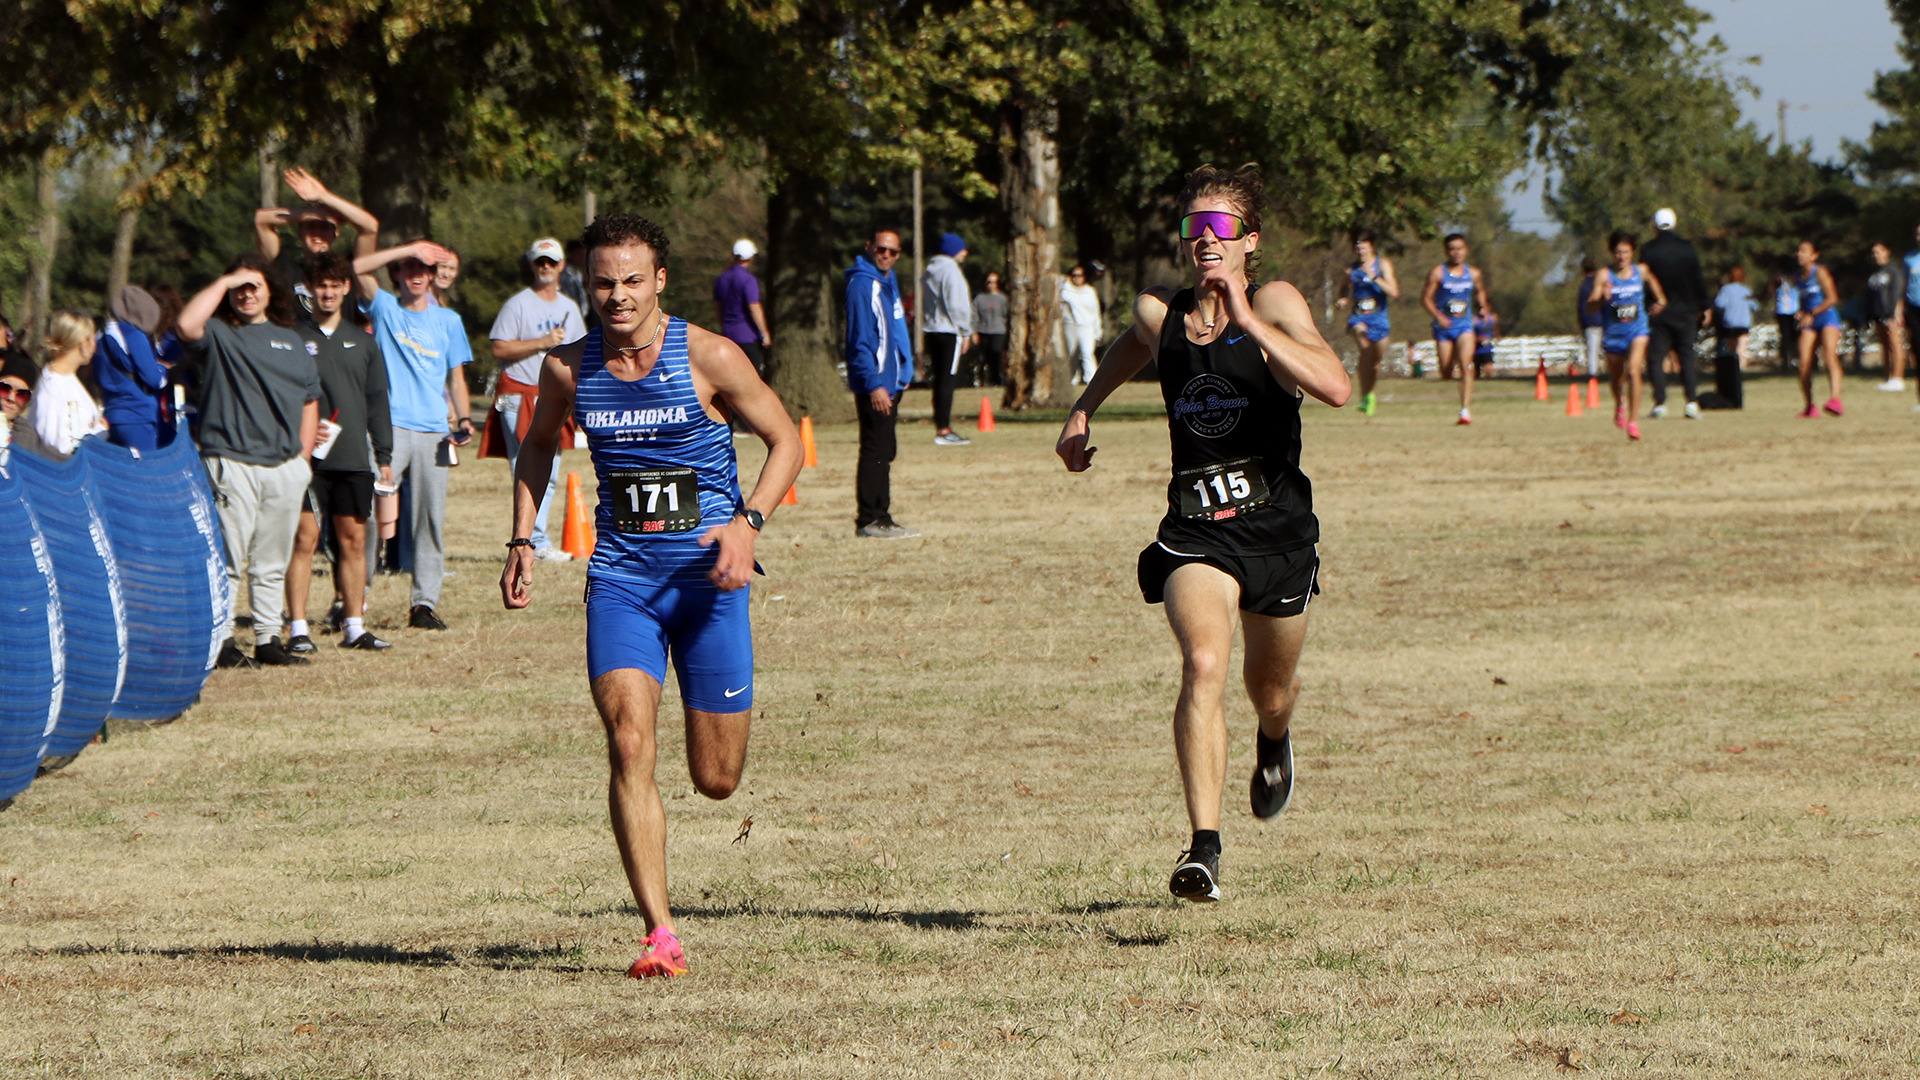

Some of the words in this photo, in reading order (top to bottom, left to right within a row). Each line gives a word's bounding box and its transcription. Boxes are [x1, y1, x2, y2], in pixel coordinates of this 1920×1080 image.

[1186, 378, 1205, 395] CROSS
[1206, 377, 1232, 394] COUNTRY
[1173, 396, 1204, 420] John
[1206, 394, 1249, 410] Brown
[585, 407, 689, 428] OKLAHOMA
[1191, 420, 1212, 434] TRACK
[1219, 416, 1235, 432] FIELD
[614, 428, 659, 443] CITY
[625, 482, 679, 513] 171
[1192, 470, 1251, 508] 115
[642, 520, 666, 532] SAC
